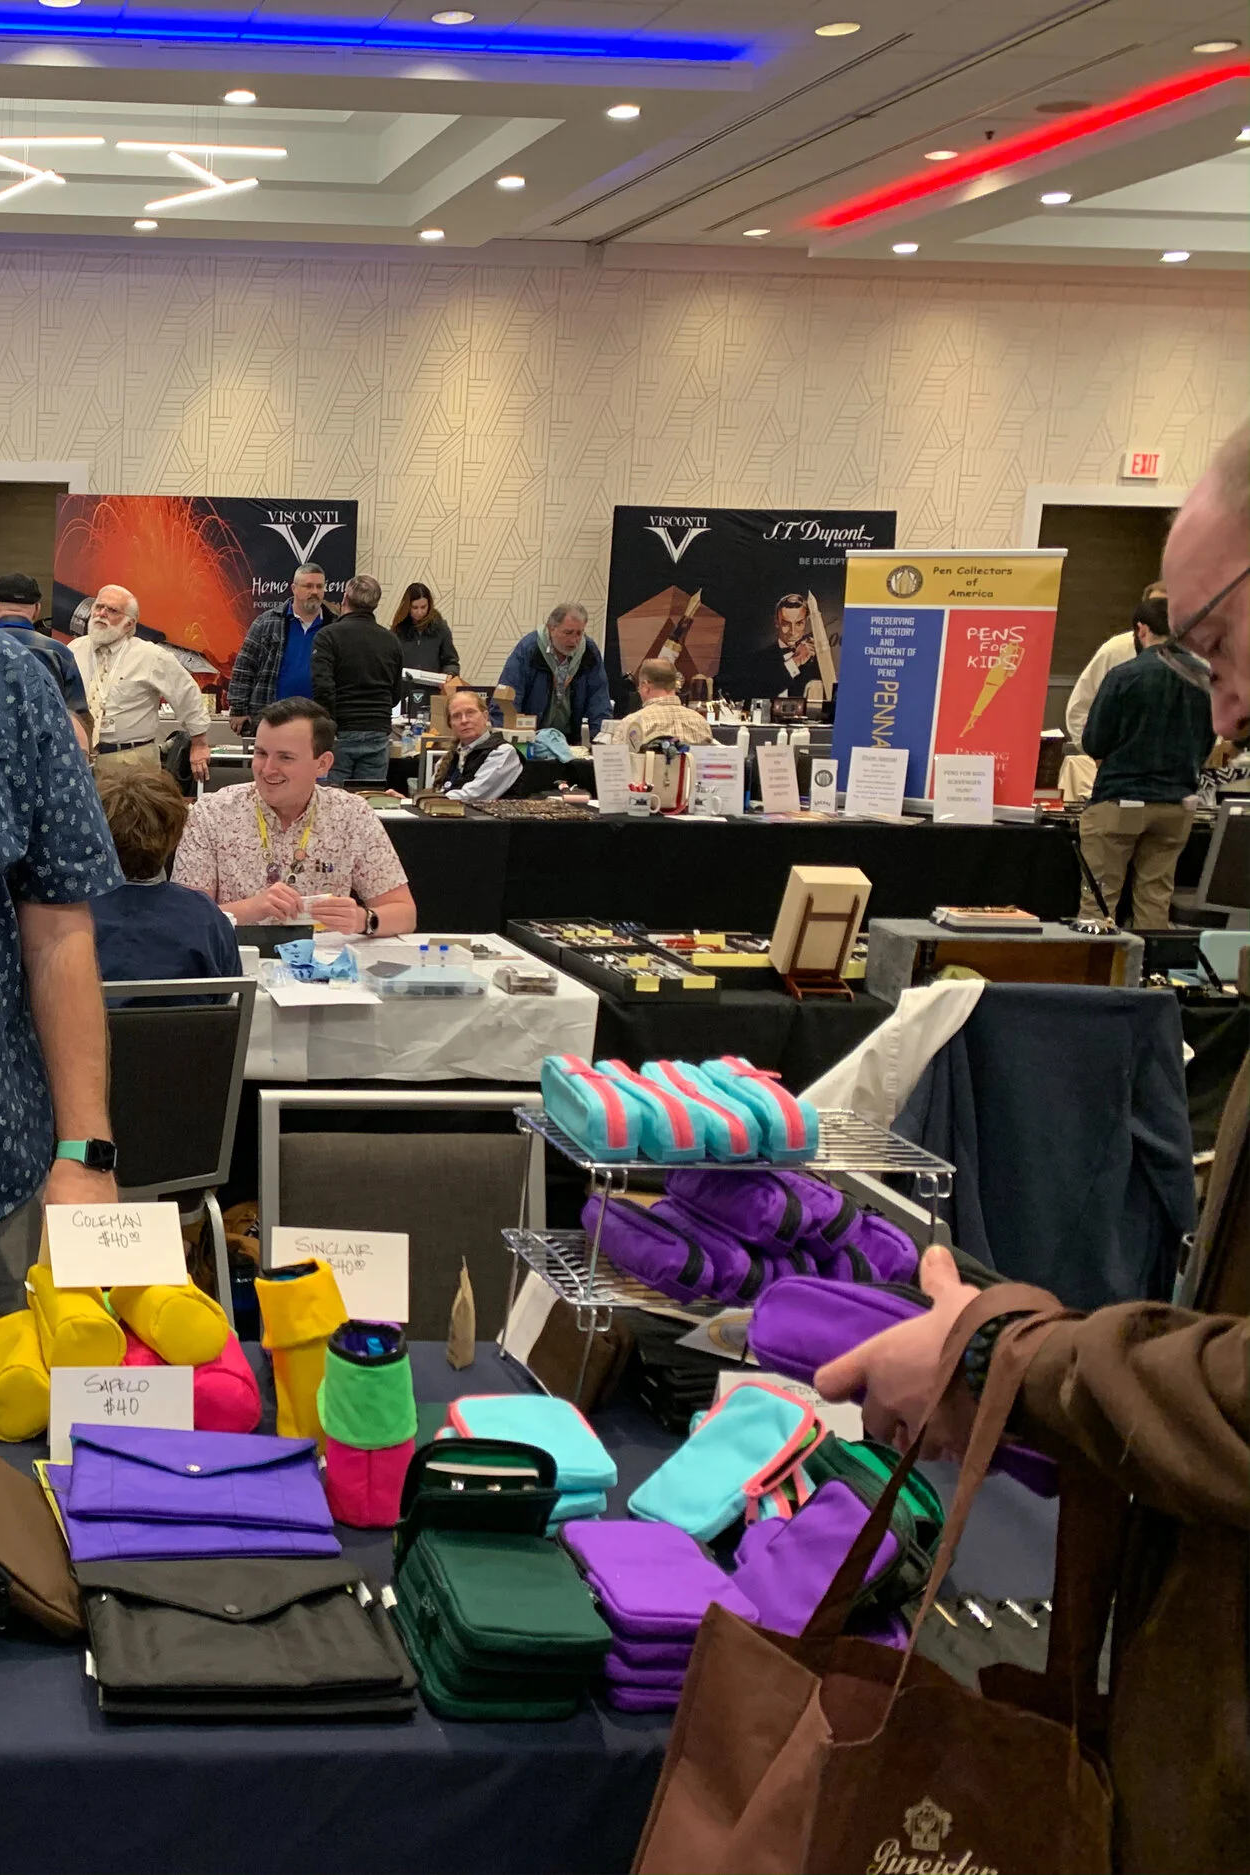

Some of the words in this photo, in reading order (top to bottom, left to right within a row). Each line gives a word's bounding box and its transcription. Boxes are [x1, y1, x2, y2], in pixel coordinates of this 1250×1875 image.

[1131, 453, 1160, 475] EXIT
[267, 510, 339, 523] VISCONTI
[649, 515, 708, 528] VISCONTI
[799, 519, 875, 547] Dupont
[799, 557, 811, 565] BE
[813, 557, 847, 566] EXCEPT
[933, 566, 952, 575] Pen
[957, 566, 1013, 576] Collectors
[966, 578, 978, 587] of
[948, 589, 994, 598] America
[870, 616, 915, 626] PRESERVING
[870, 627, 884, 635] THE
[885, 628, 916, 637] HISTORY
[966, 626, 1026, 643] PENS
[879, 638, 894, 647] AND
[980, 642, 1008, 653] FOR
[864, 646, 906, 656] ENJOYMENT
[907, 648, 917, 656] OF
[869, 657, 904, 667] FOUNTAIN
[967, 654, 1019, 671] KIDS
[877, 668, 896, 677] PENS
[870, 680, 899, 748] PENNA
[71, 1209, 143, 1230] COLEMAN
[294, 1236, 374, 1257] SINCLAIR
[84, 1373, 150, 1395] SAPELO
[103, 1396, 140, 1416] $40
